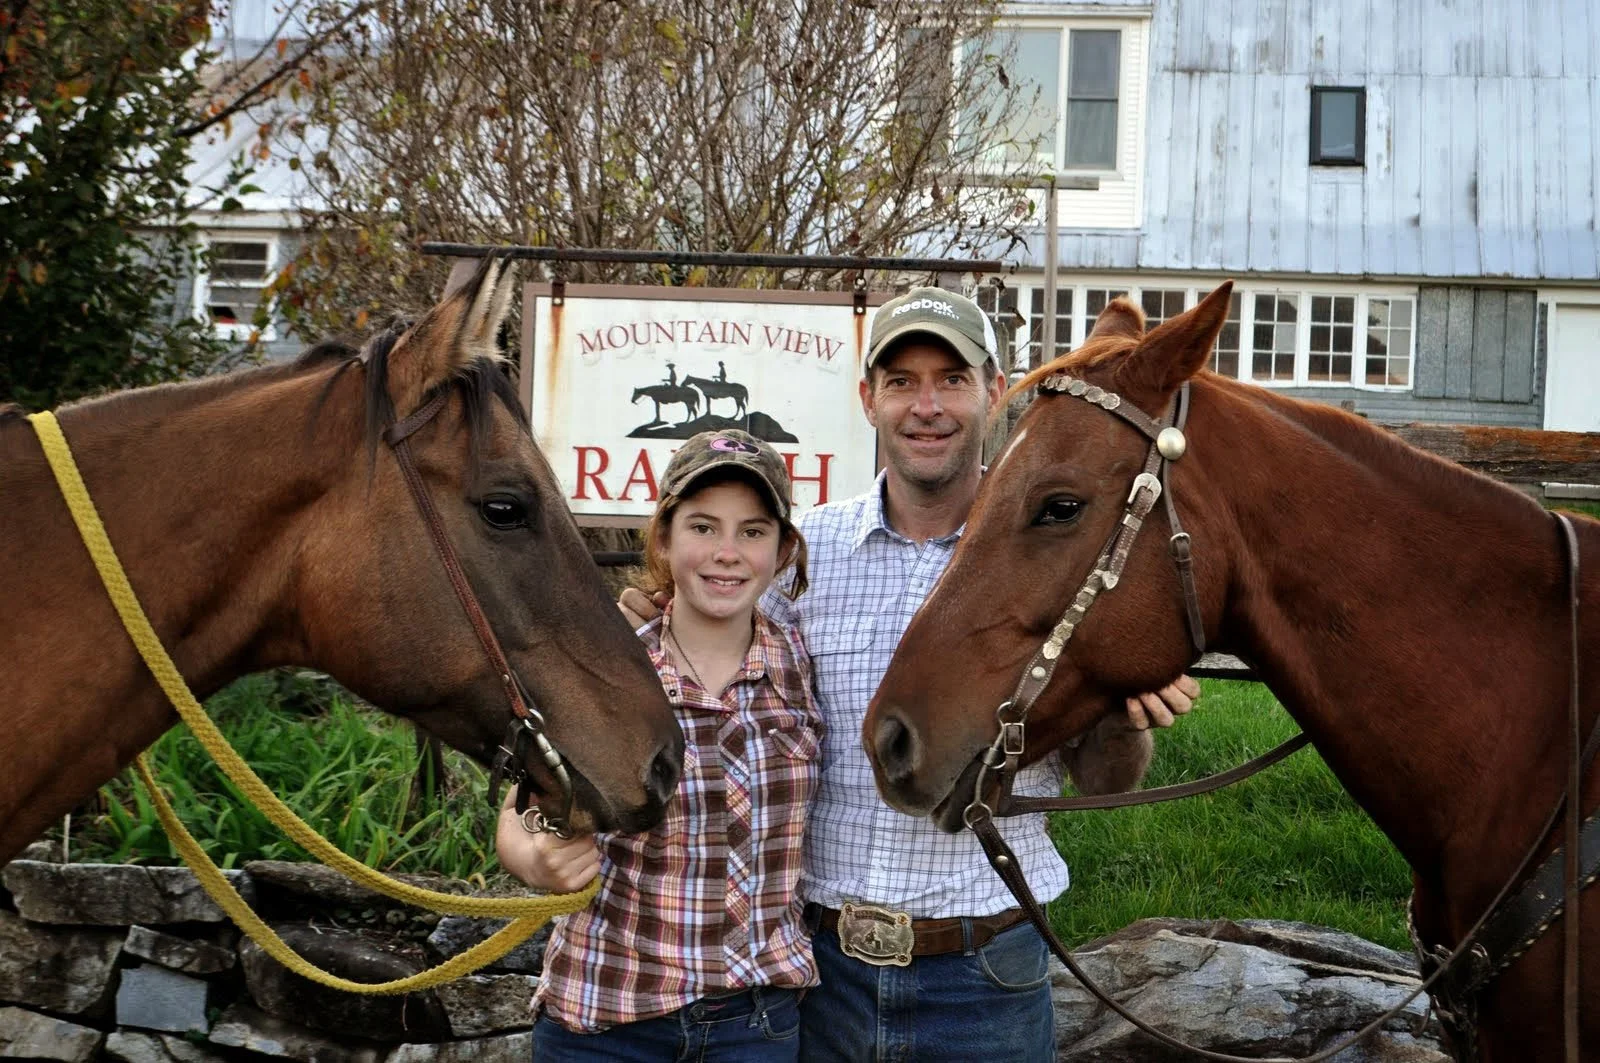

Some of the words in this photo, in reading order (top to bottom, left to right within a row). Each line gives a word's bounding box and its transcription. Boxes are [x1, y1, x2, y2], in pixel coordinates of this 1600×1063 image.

[892, 298, 953, 318] Reebok
[577, 320, 752, 355] MOUNTAIN
[763, 325, 845, 362] VIEW
[572, 446, 834, 506] RAH
